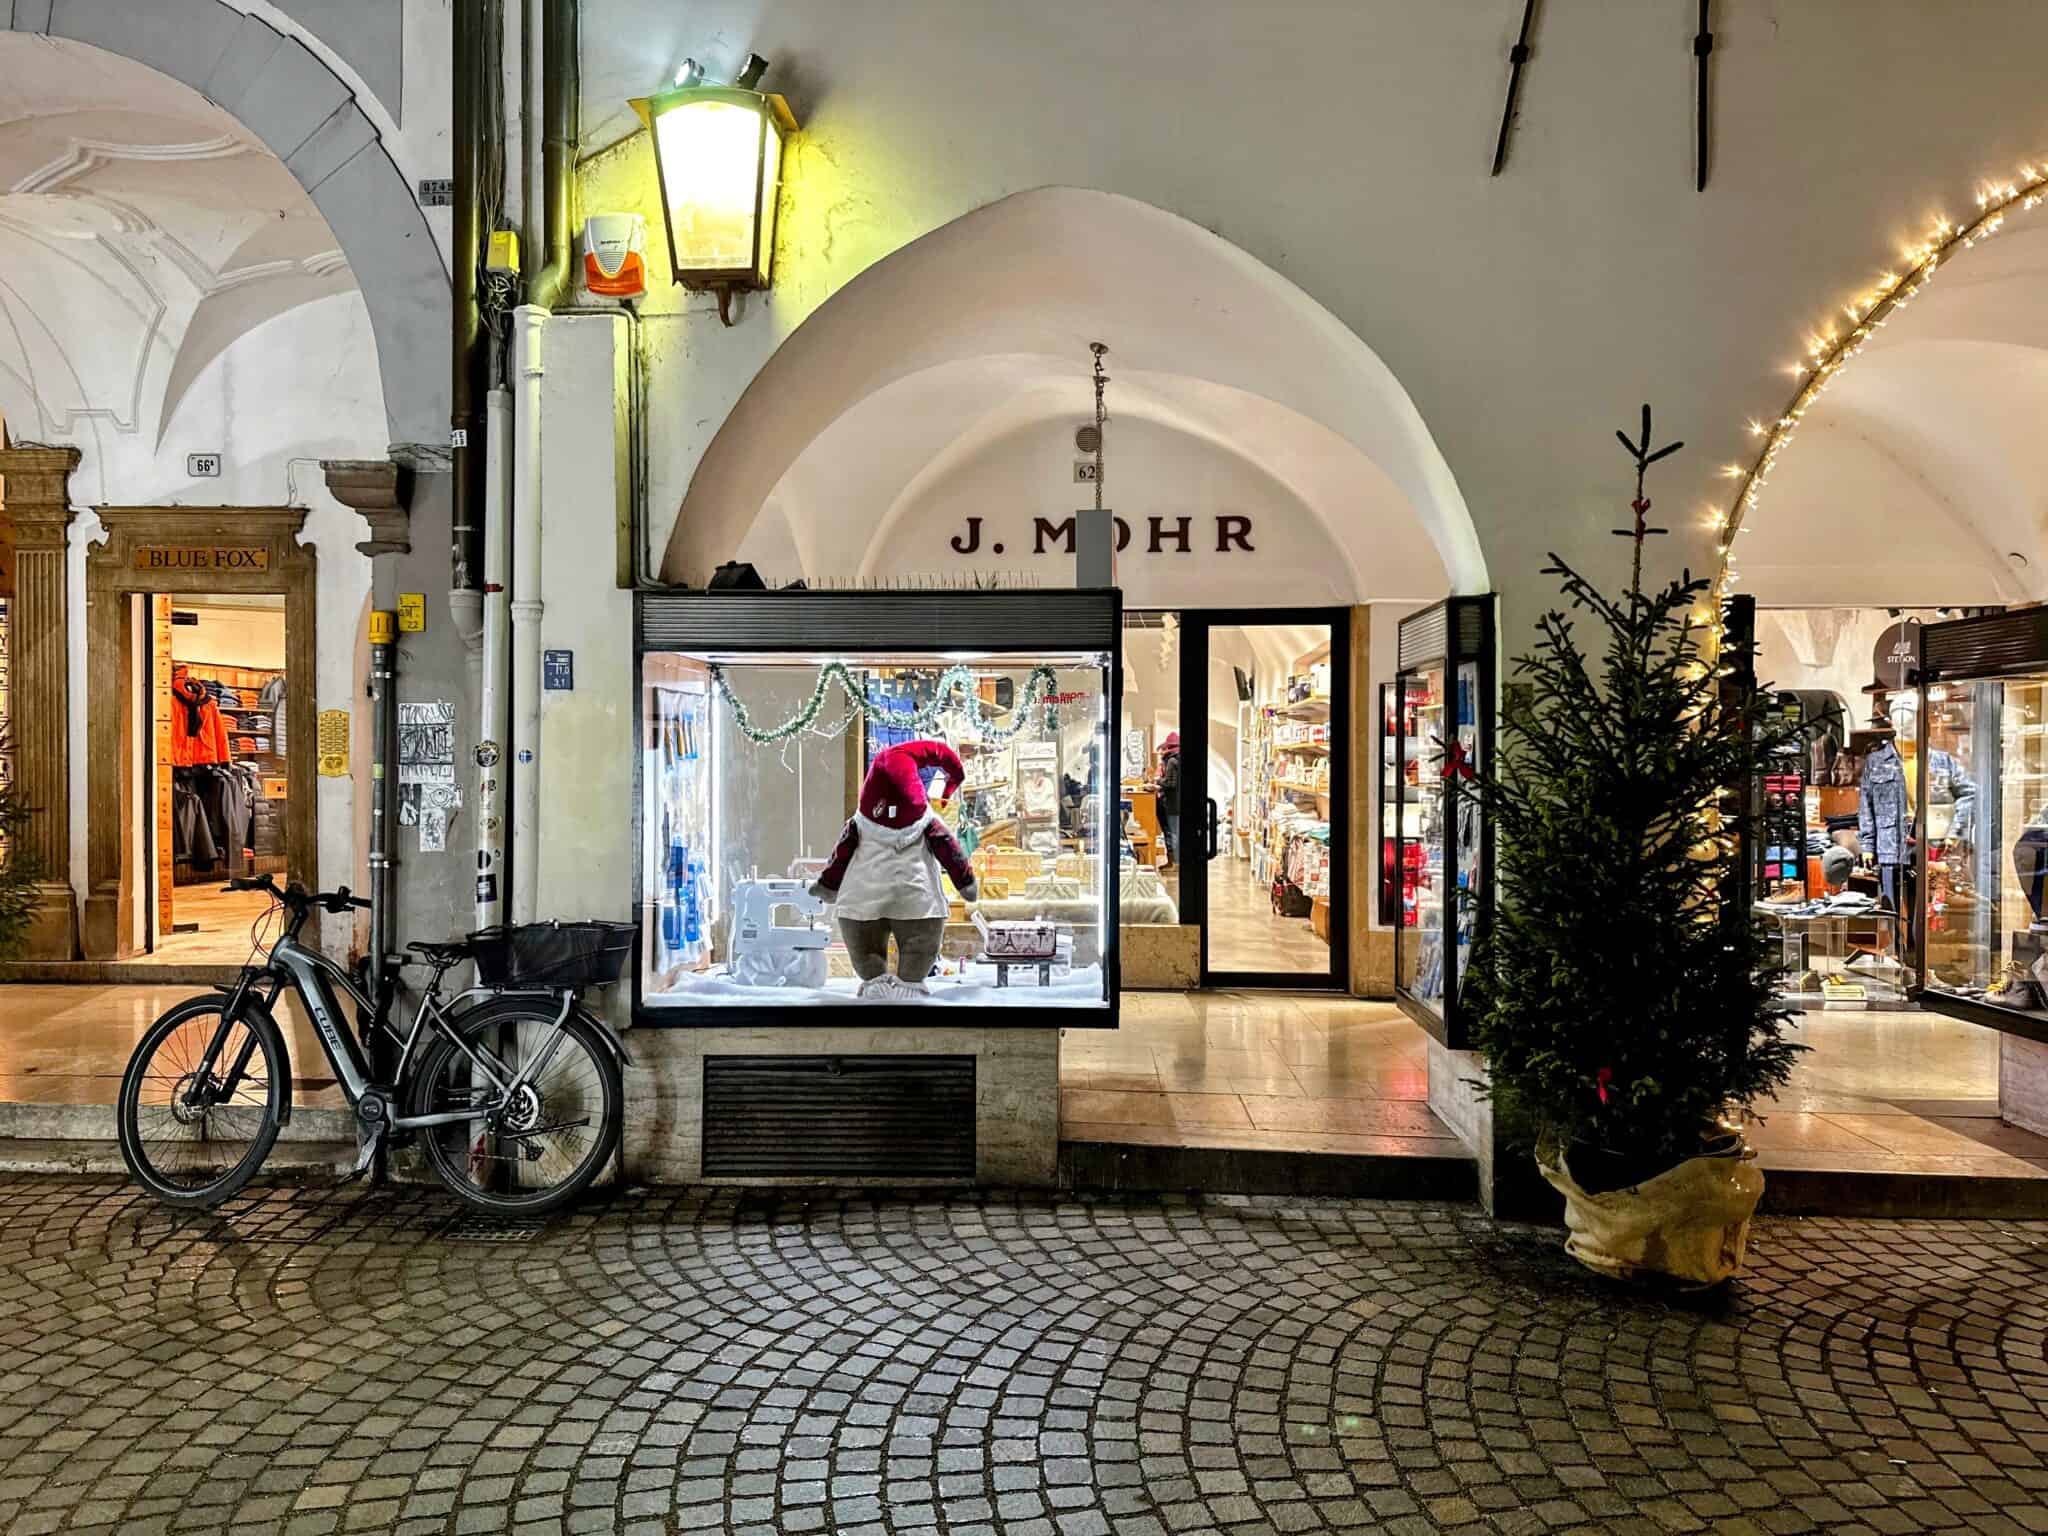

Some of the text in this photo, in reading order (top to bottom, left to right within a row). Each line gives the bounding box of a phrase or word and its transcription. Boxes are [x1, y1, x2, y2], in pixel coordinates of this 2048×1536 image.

[1079, 465, 1096, 479] 62
[950, 517, 1004, 554] J.
[150, 550, 258, 567] BLUE FOX
[314, 1007, 342, 1050] CUBE
